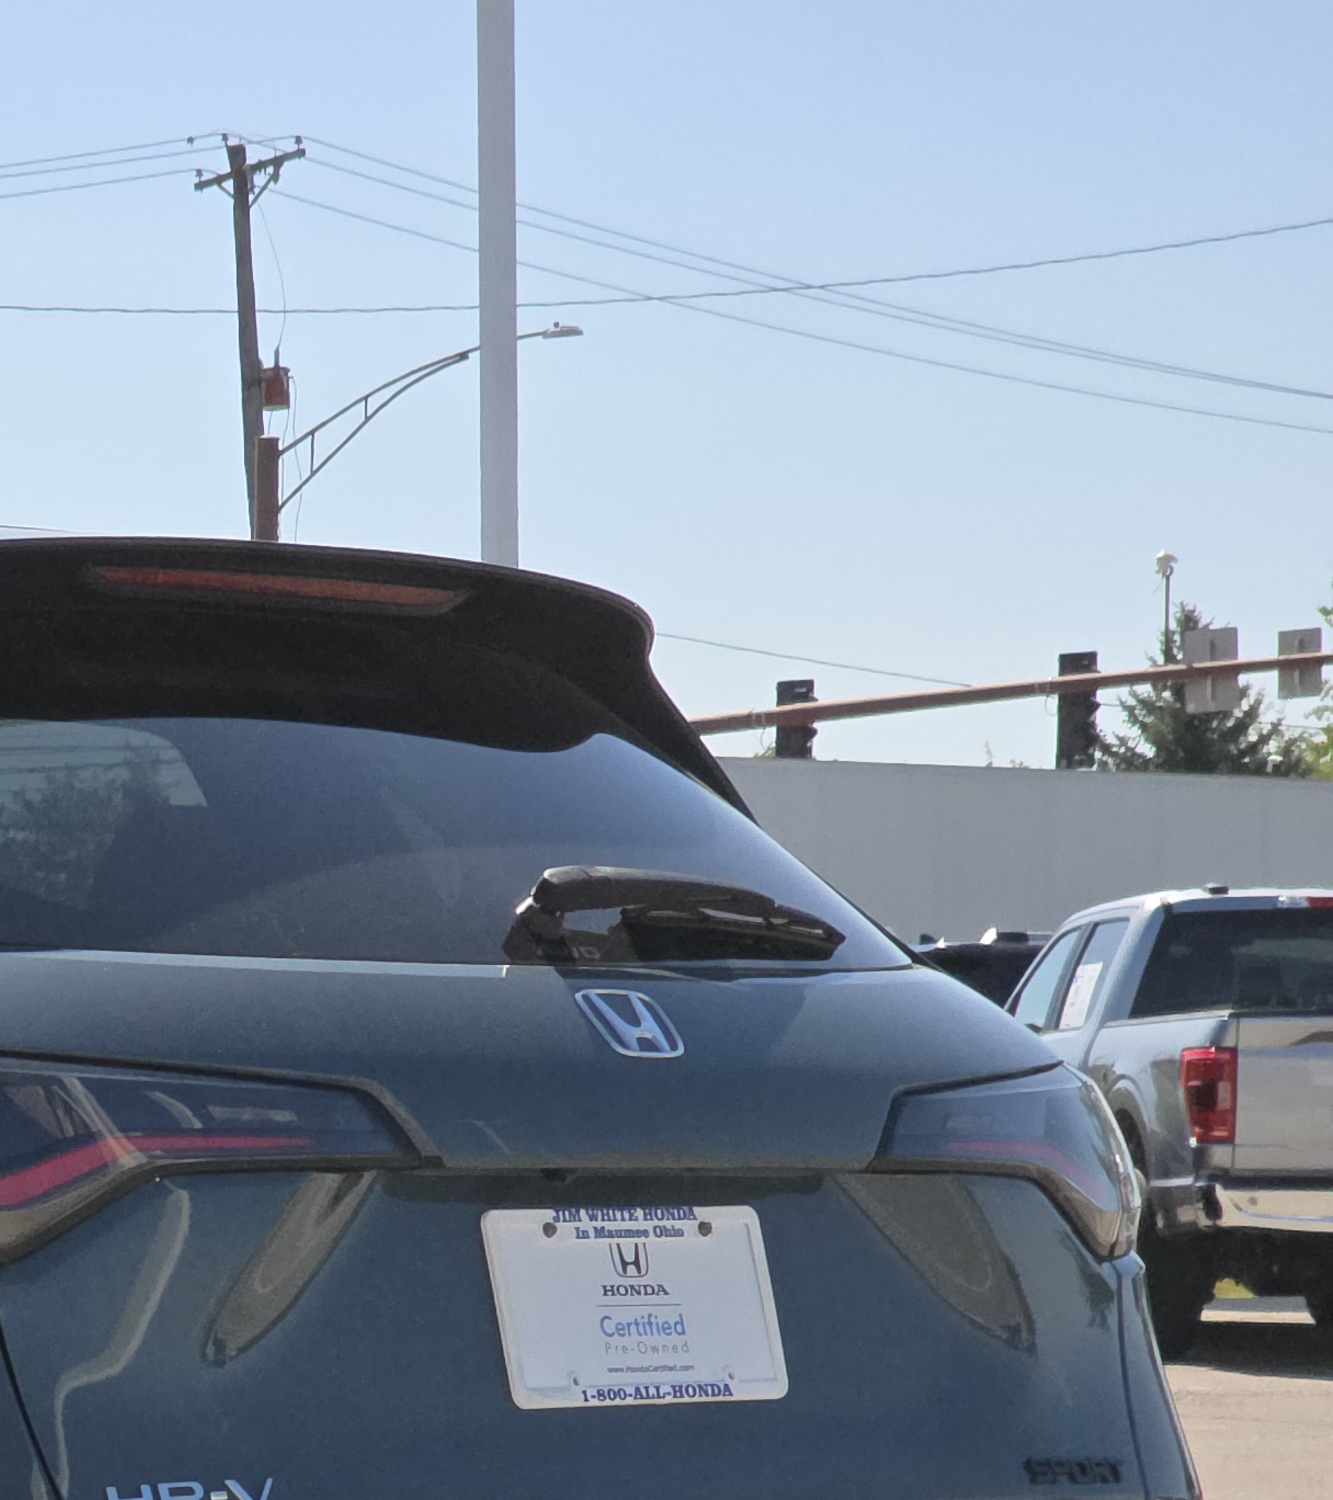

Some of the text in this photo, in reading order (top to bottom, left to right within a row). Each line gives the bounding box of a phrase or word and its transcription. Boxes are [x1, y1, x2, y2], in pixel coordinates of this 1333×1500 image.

[552, 1205, 698, 1222] JIM WHITE HONDA
[574, 1225, 684, 1238] In Maumee Ohio
[600, 1284, 670, 1296] HONDA
[599, 1313, 686, 1337] Certified
[604, 1340, 689, 1355] Pre-Owned
[581, 1383, 734, 1401] 1-800-ALL-HONDA
[1023, 1456, 1123, 1484] SPORT
